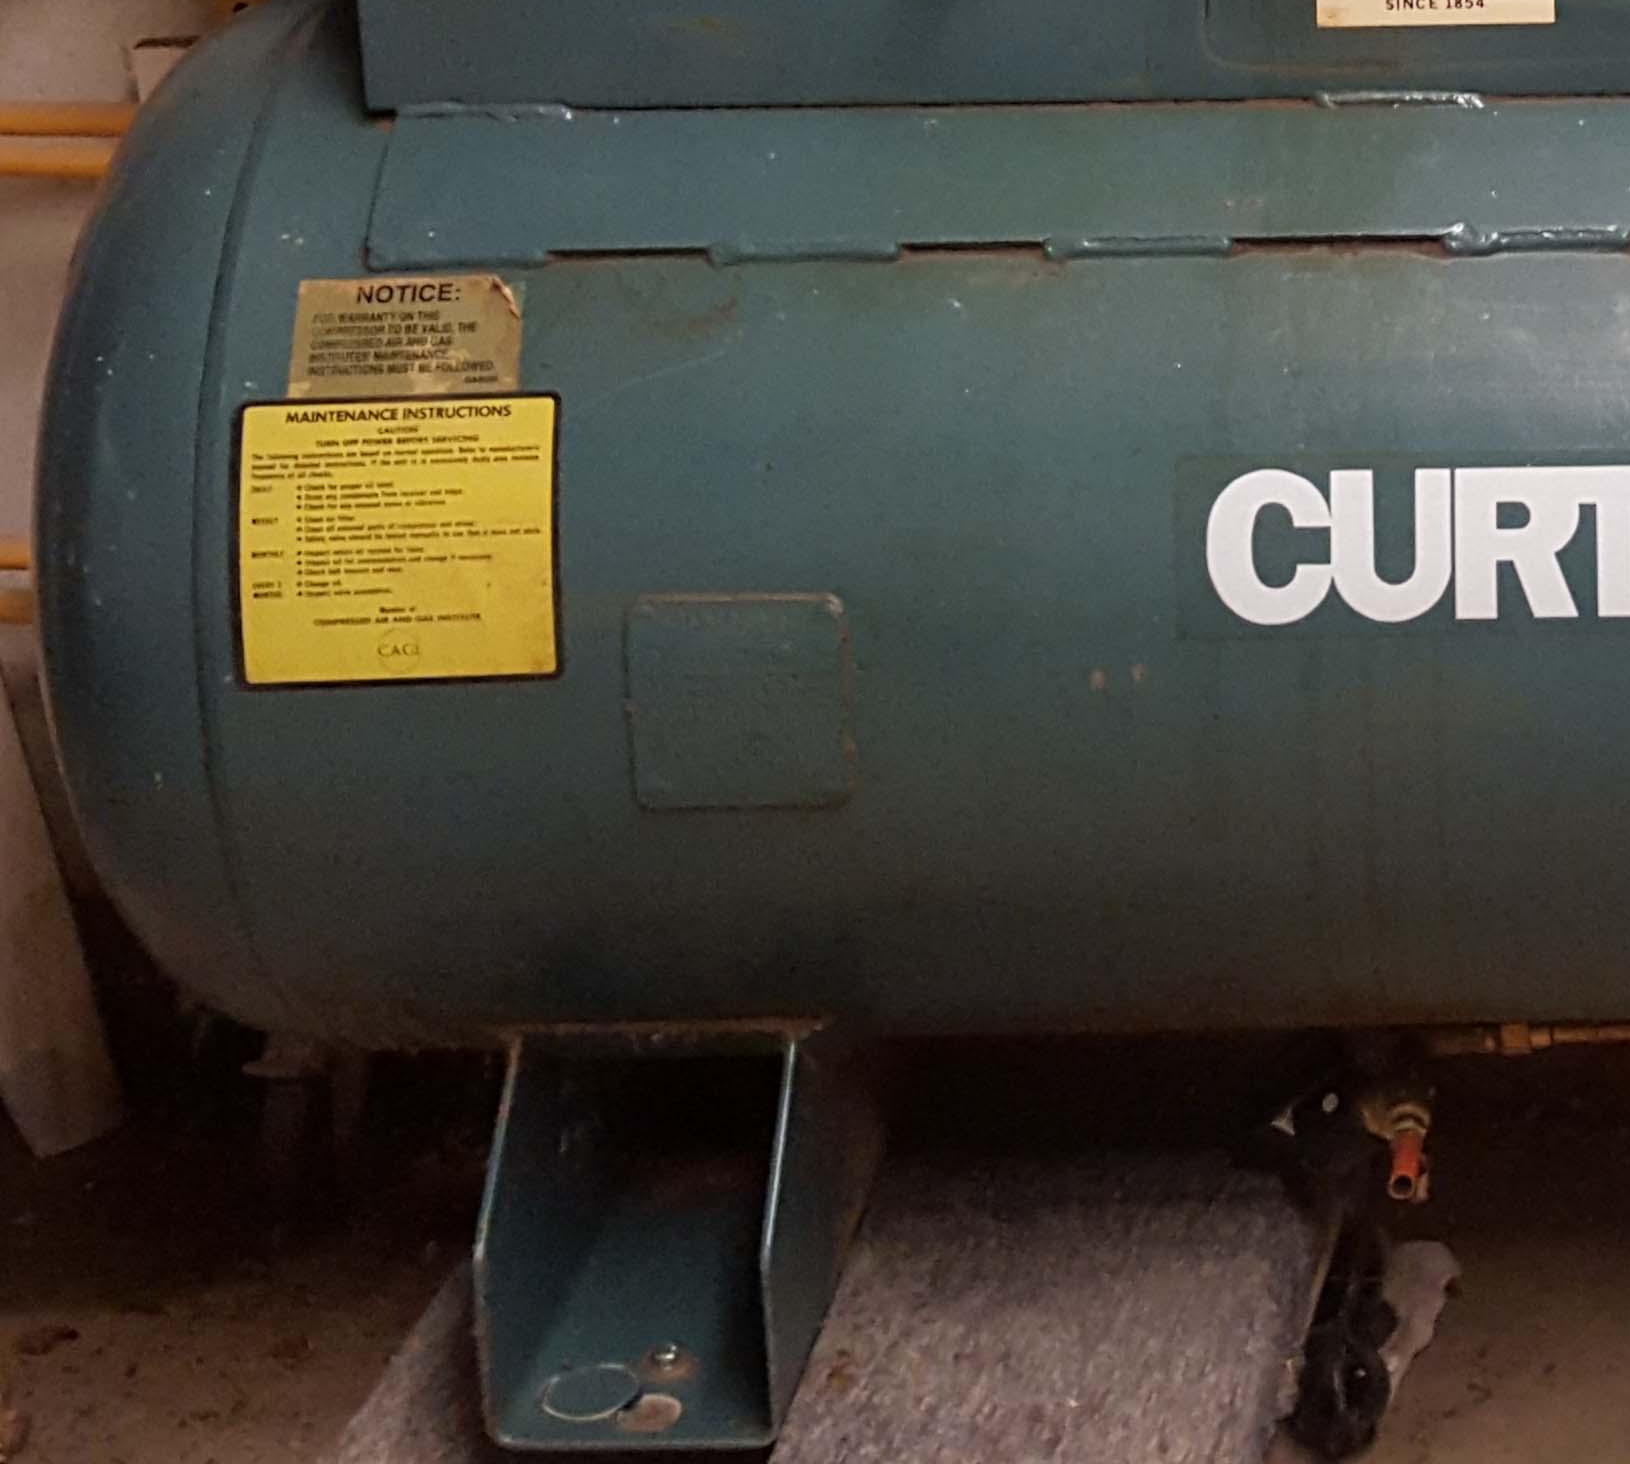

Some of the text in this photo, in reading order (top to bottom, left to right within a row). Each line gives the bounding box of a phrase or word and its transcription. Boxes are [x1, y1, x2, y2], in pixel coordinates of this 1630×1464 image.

[356, 283, 461, 304] NOTICE:
[285, 405, 512, 423] MAINTENANCE INSTRUCTIONS
